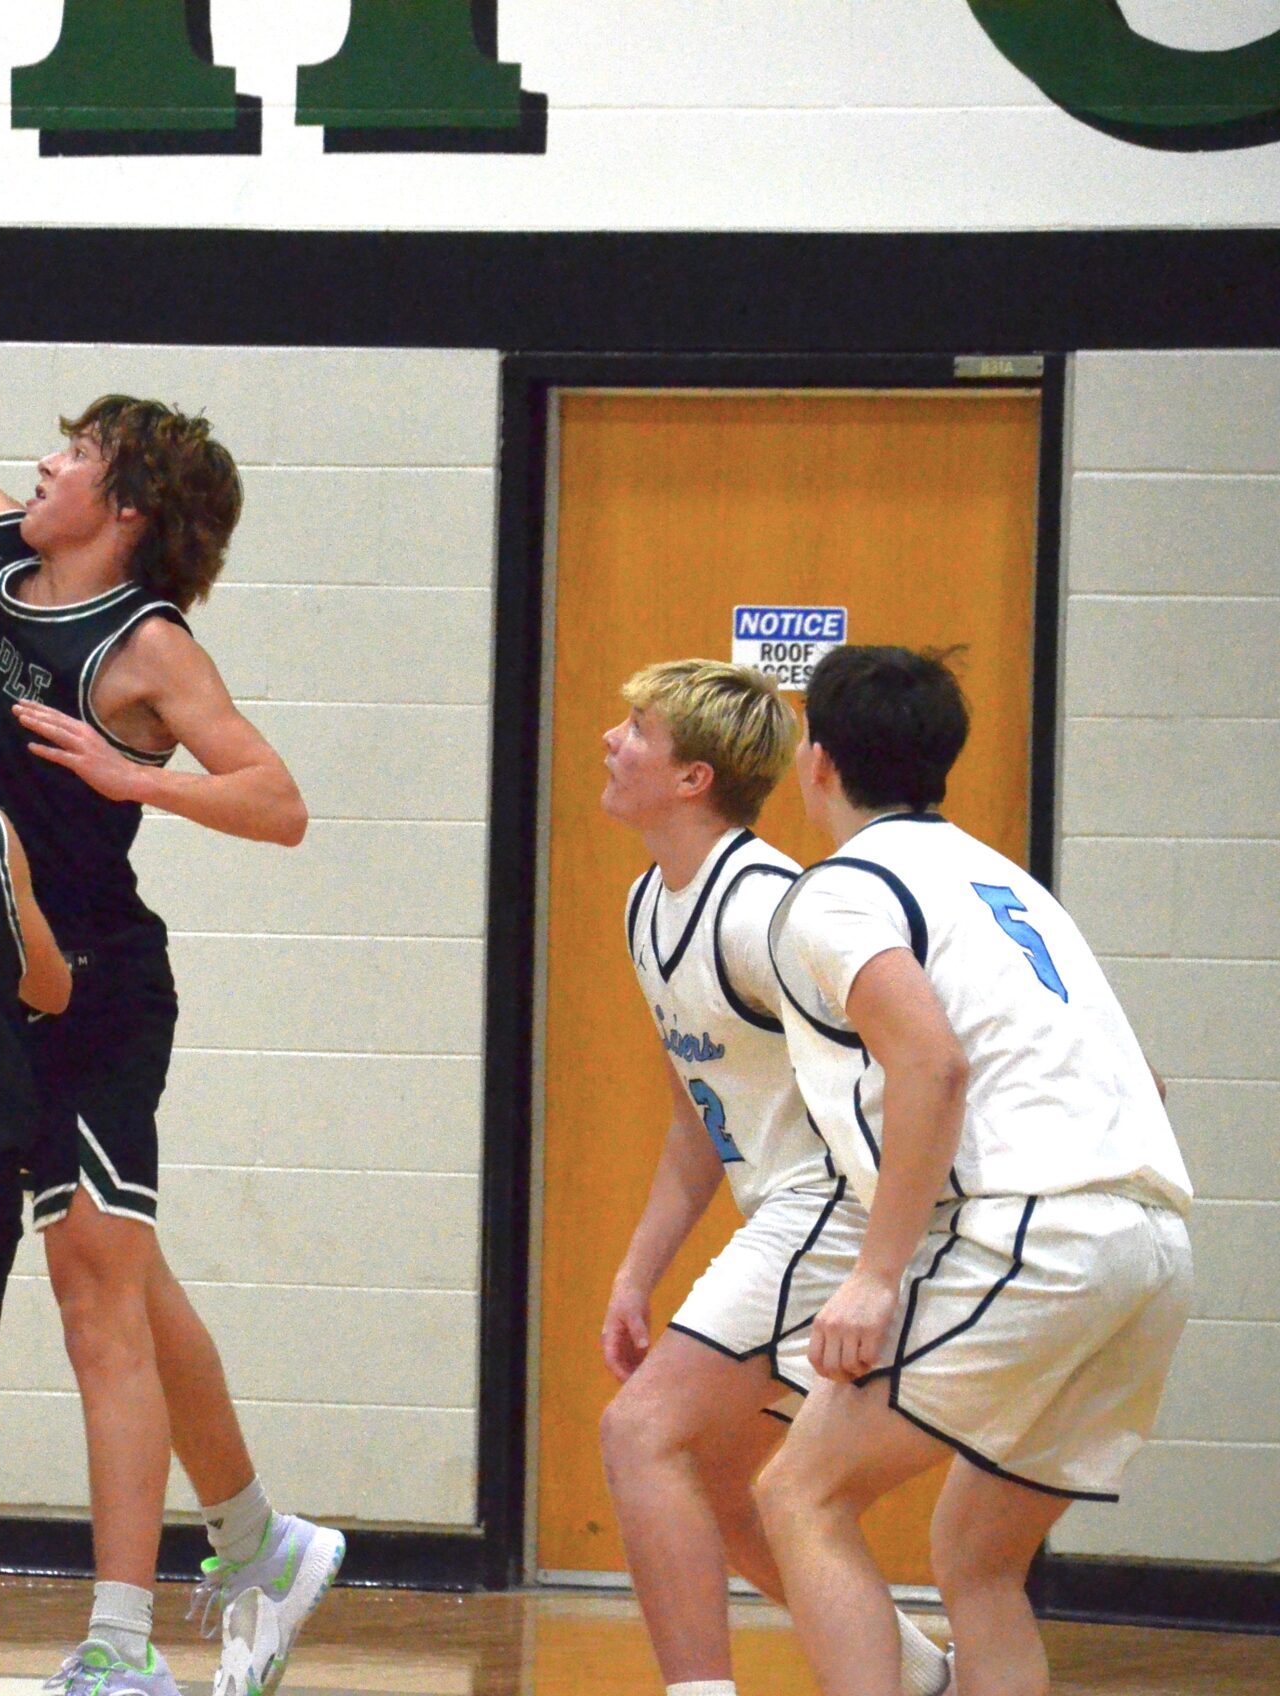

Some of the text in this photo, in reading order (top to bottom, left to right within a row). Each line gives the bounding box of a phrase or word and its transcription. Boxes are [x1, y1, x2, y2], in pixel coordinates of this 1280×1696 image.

[739, 611, 841, 637] NOTICE
[760, 643, 815, 662] ROOF
[970, 881, 1069, 1004] 5
